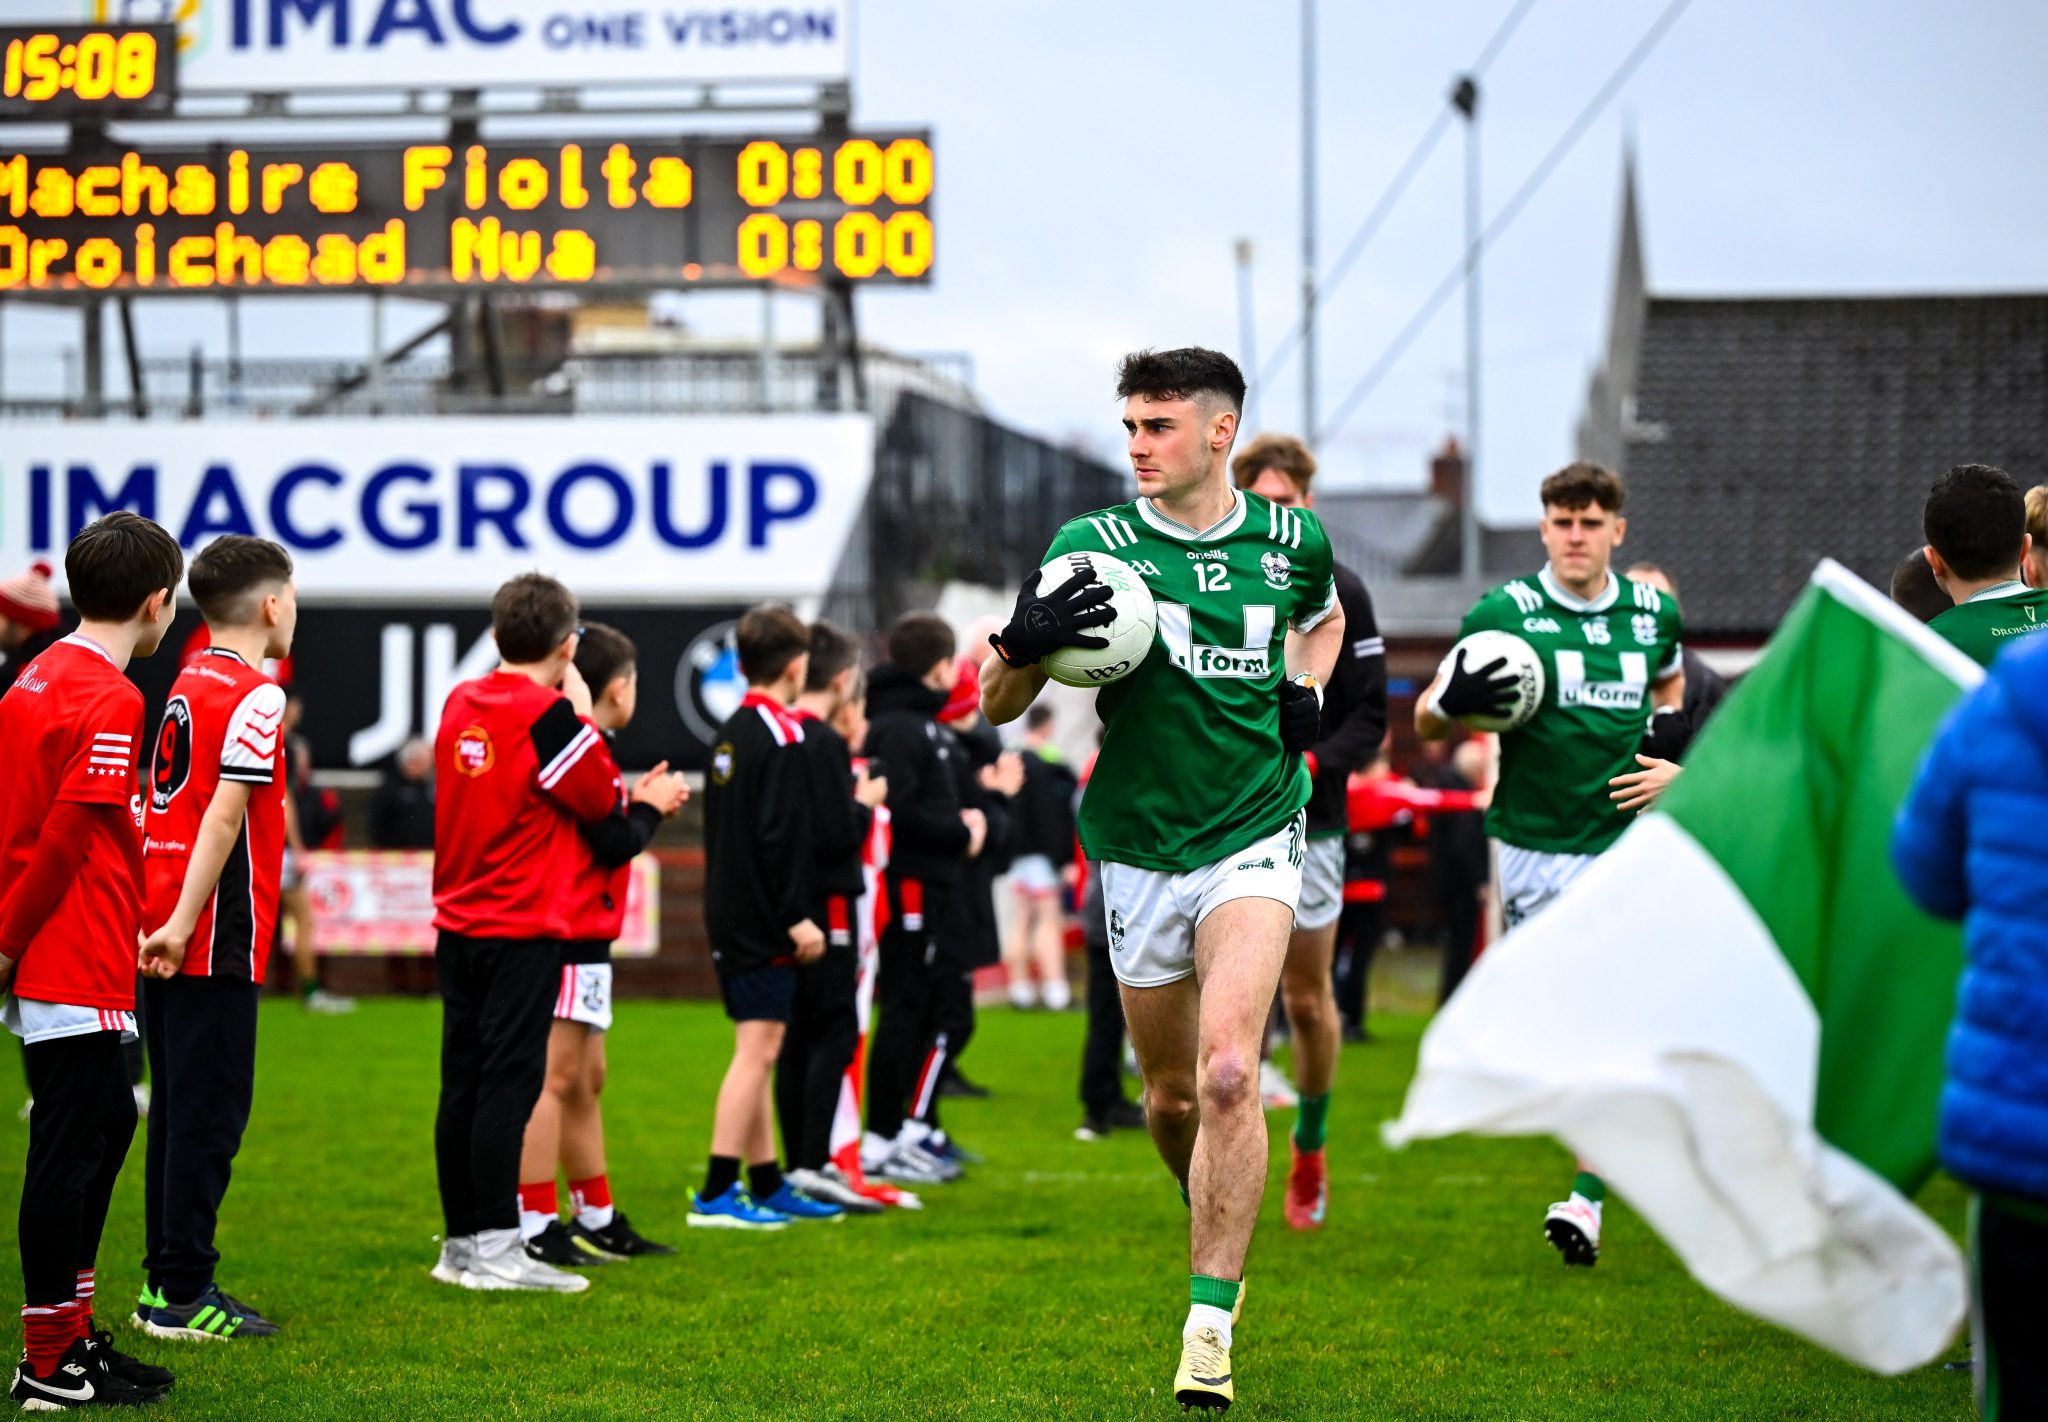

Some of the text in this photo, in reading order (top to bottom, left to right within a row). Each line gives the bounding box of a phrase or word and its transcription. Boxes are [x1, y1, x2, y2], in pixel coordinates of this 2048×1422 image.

[541, 14, 645, 49] ONE
[663, 9, 837, 47] VISION
[4, 32, 157, 100] 15:08
[403, 143, 692, 211] Fiolta
[737, 139, 933, 207] 0:00
[451, 216, 595, 282] Nua
[737, 211, 933, 278] 0:00
[1192, 562, 1232, 593] 12
[1581, 621, 1612, 645] 15
[1199, 648, 1267, 674] form
[157, 719, 177, 783] 9
